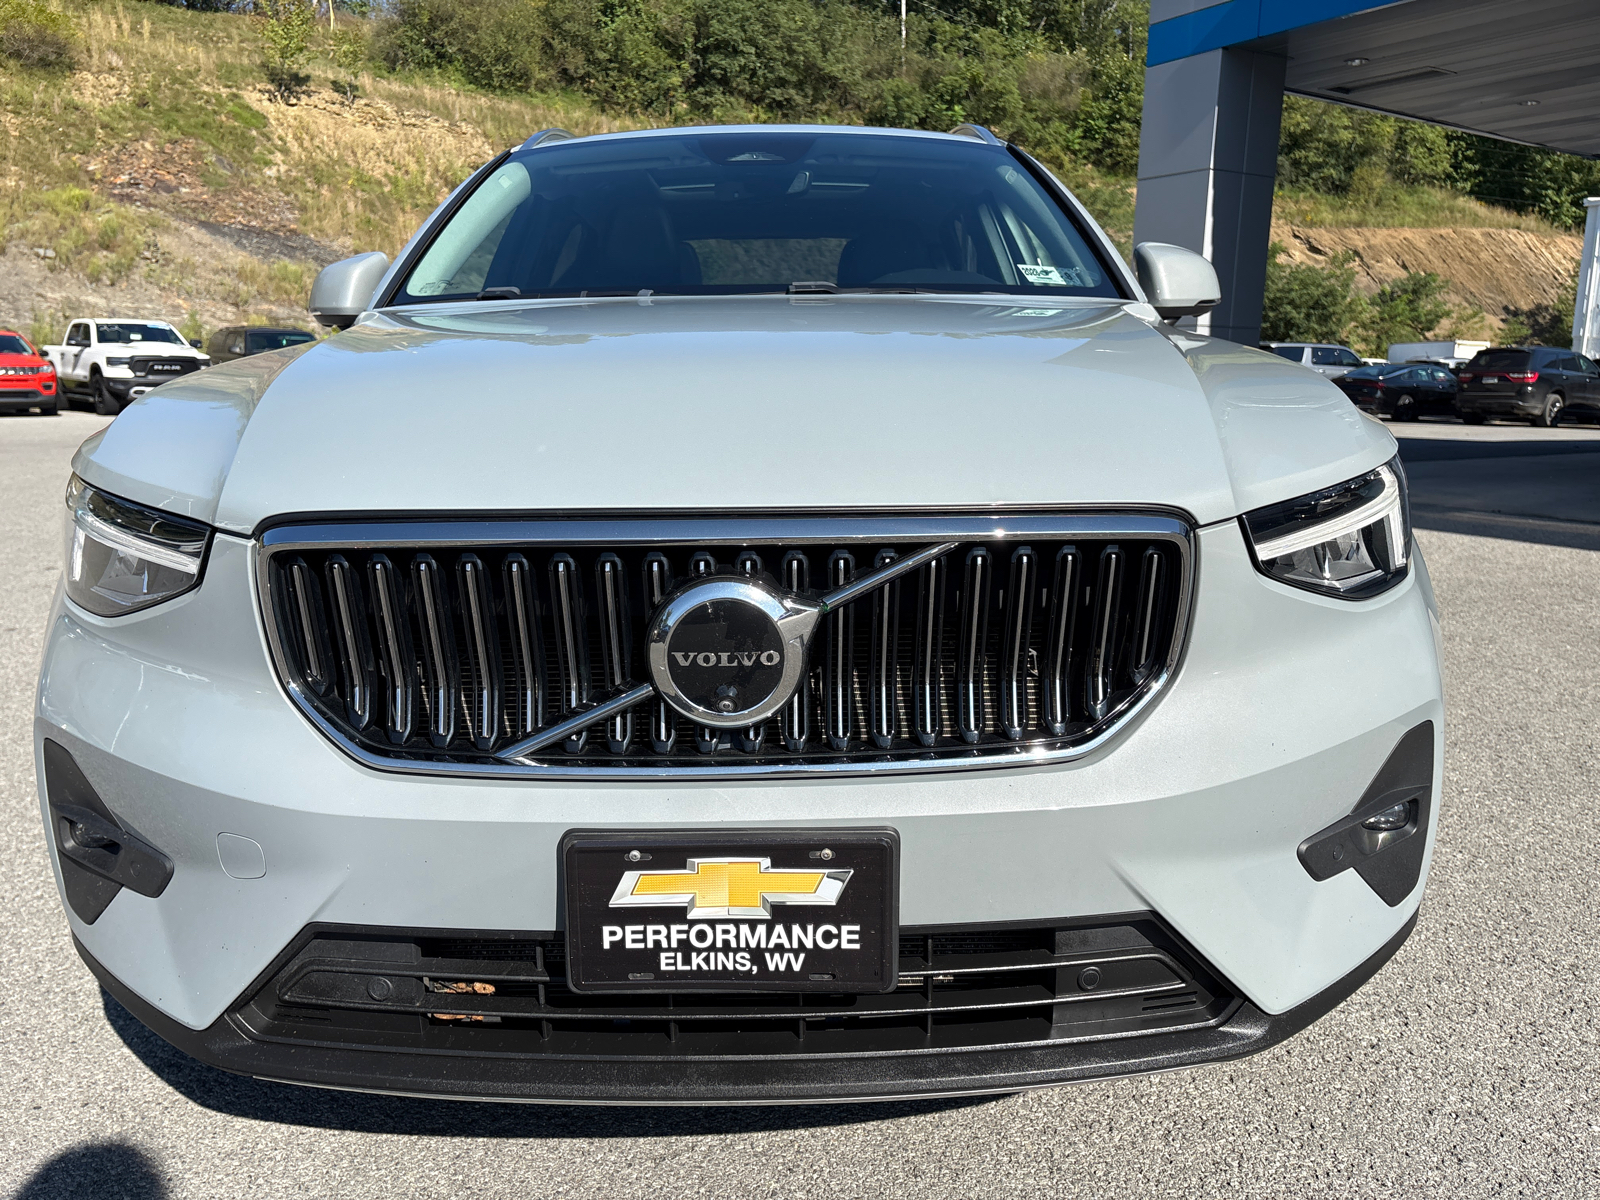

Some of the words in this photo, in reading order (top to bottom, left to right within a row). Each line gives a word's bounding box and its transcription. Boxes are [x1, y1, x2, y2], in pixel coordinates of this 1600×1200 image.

[672, 650, 781, 667] VOLVO
[602, 923, 861, 950] PERFORMANCE
[659, 951, 758, 975] ELKINS,
[764, 952, 806, 972] WV
